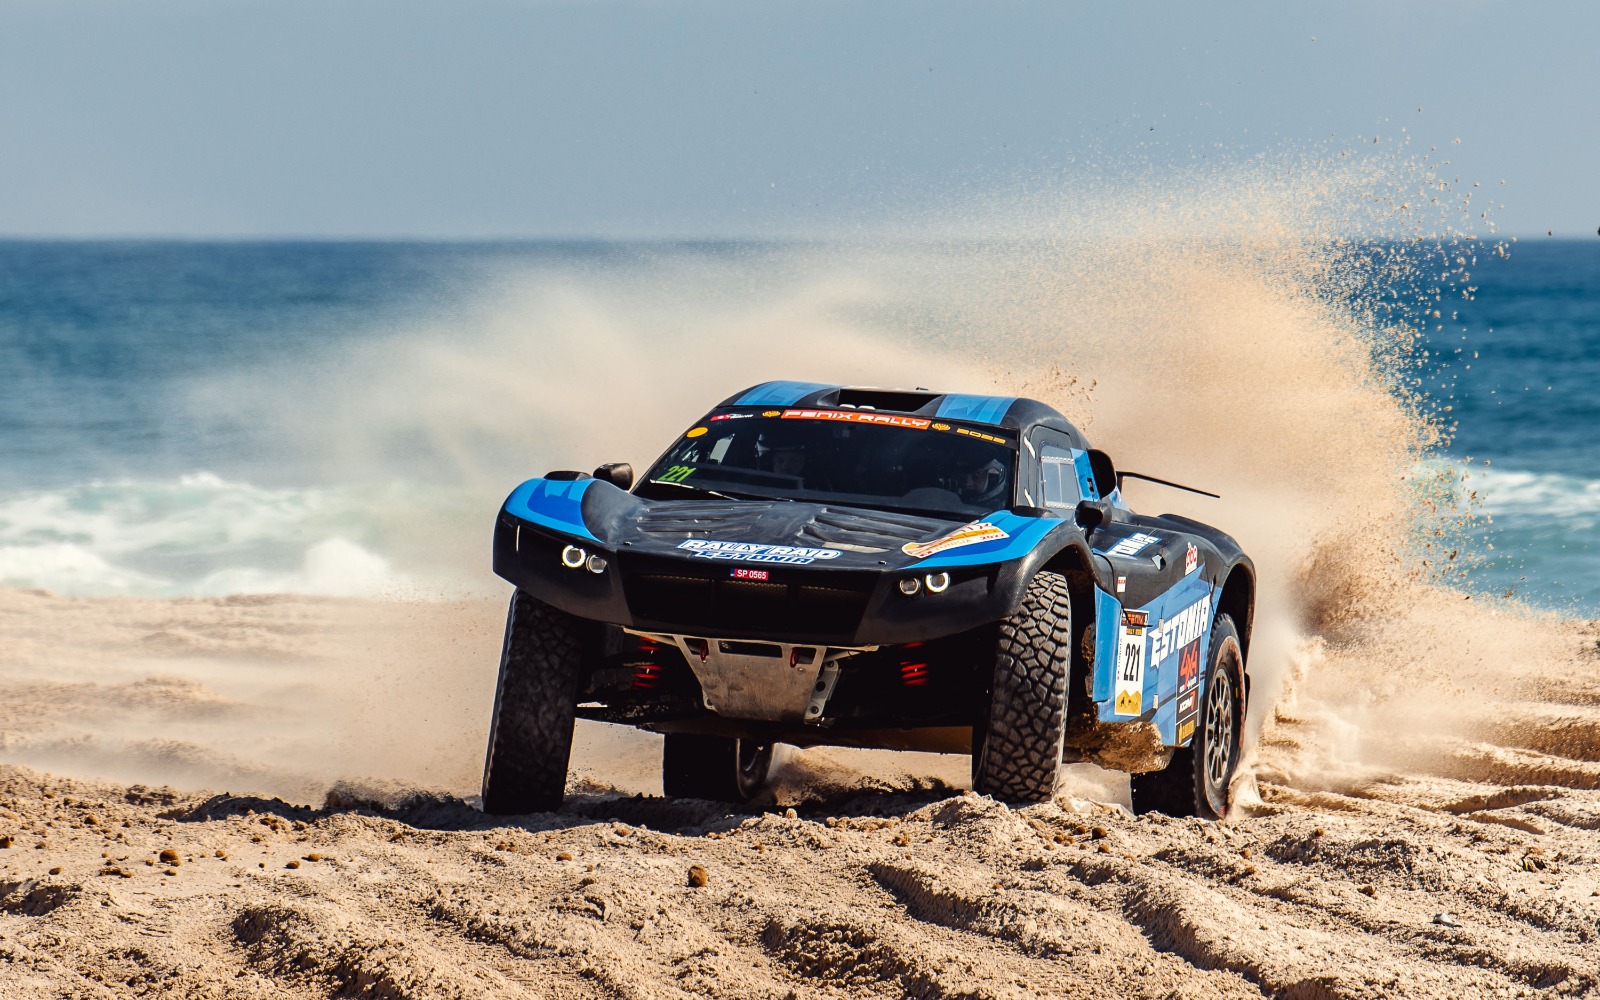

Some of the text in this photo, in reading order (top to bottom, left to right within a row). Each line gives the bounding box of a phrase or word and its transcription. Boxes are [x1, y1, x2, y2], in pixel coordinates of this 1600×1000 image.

[785, 411, 852, 420] FENIX
[858, 414, 928, 426] RALLY
[658, 465, 697, 482] 221
[681, 540, 840, 559] RALLY RAID
[697, 551, 813, 564] ESTONIA
[737, 569, 767, 580] SP 0565
[1148, 593, 1211, 668] ESTONIA
[1123, 643, 1141, 682] 221
